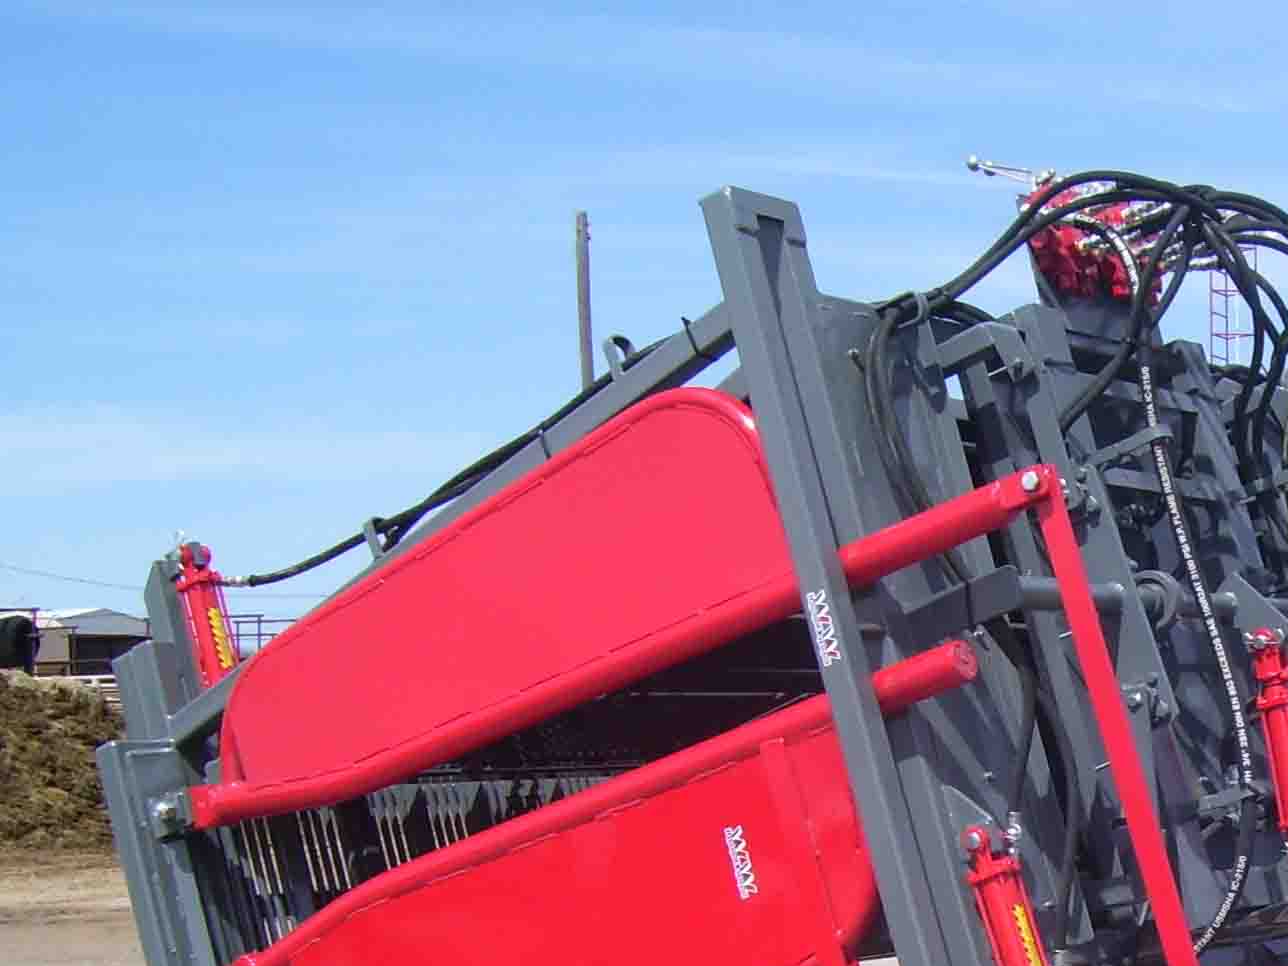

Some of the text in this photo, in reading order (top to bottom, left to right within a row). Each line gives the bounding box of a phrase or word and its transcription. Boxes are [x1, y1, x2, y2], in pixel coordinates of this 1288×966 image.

[1153, 445, 1173, 493] RESISTANT
[1166, 493, 1183, 525] FLAME
[1206, 617, 1220, 637] SAE
[1212, 637, 1233, 680] EXCEEDS
